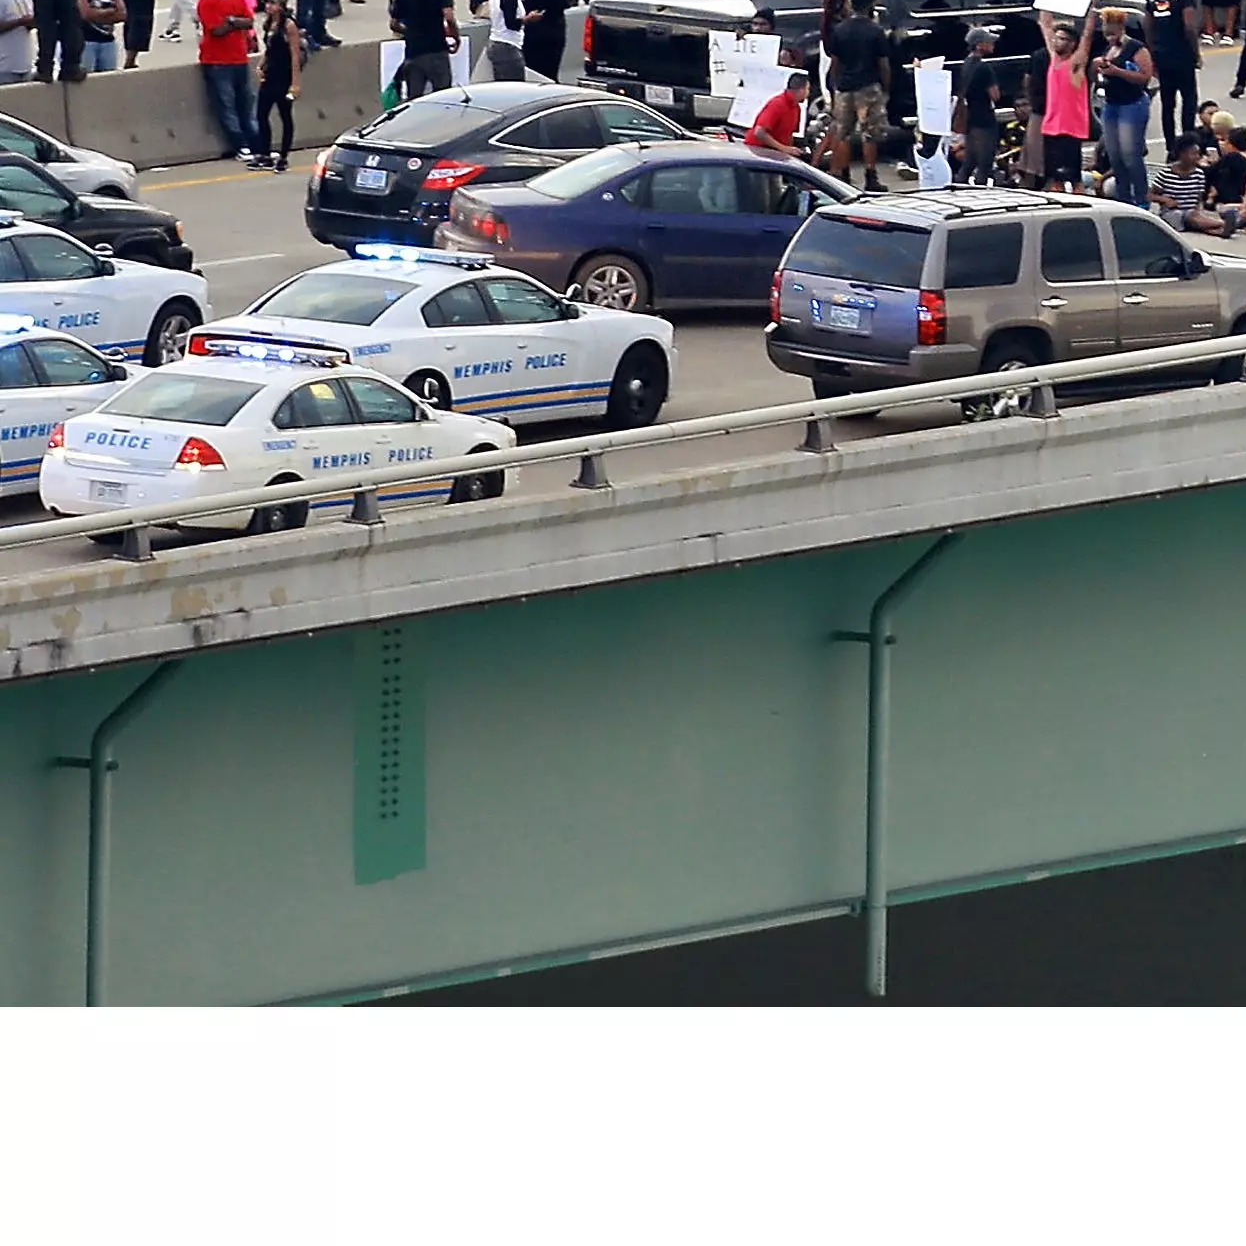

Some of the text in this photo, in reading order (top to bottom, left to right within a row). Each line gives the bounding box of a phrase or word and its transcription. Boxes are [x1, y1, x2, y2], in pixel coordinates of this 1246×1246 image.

[58, 311, 100, 328] POLICE
[454, 353, 567, 379] MEMPHIS POLICE
[85, 432, 152, 449] POLICE
[312, 446, 433, 469] MEMPHIS POLICE
